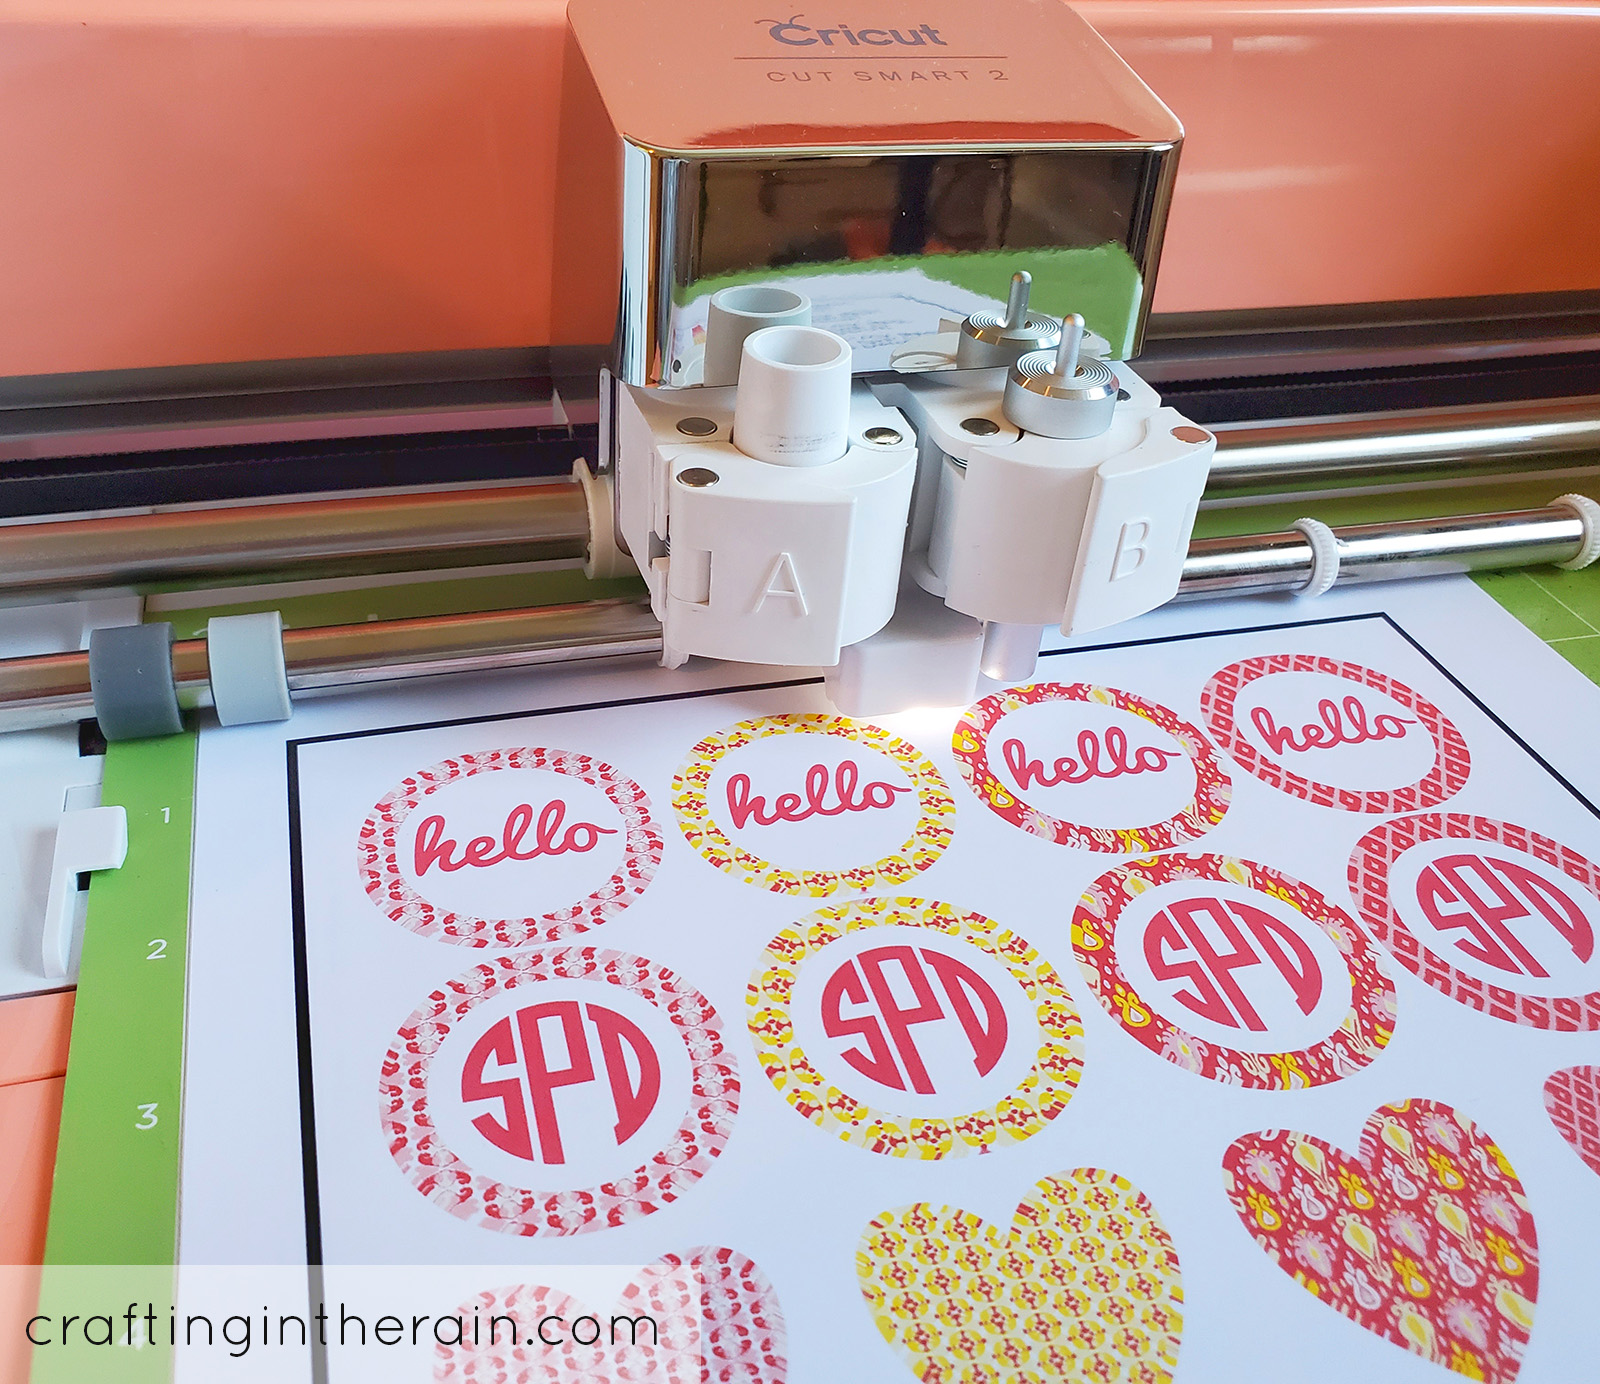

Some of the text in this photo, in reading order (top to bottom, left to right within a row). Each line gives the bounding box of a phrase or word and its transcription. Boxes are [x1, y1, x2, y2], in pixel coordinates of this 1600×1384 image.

[755, 14, 948, 46] Cricut
[766, 69, 1009, 83] CUT SMART 2
[1108, 516, 1152, 583] B
[750, 551, 809, 616] A
[1251, 696, 1416, 755] hello
[1003, 727, 1181, 790] hello
[160, 806, 171, 824] 1
[727, 760, 912, 829] hello
[415, 800, 617, 876] hello
[1416, 855, 1594, 978] SPD
[146, 938, 168, 960] 2
[1144, 898, 1322, 1032] SPD
[821, 946, 1008, 1095] SPD
[462, 1000, 660, 1165] SPD
[135, 1102, 159, 1130] 3
[117, 1317, 147, 1351] 4
